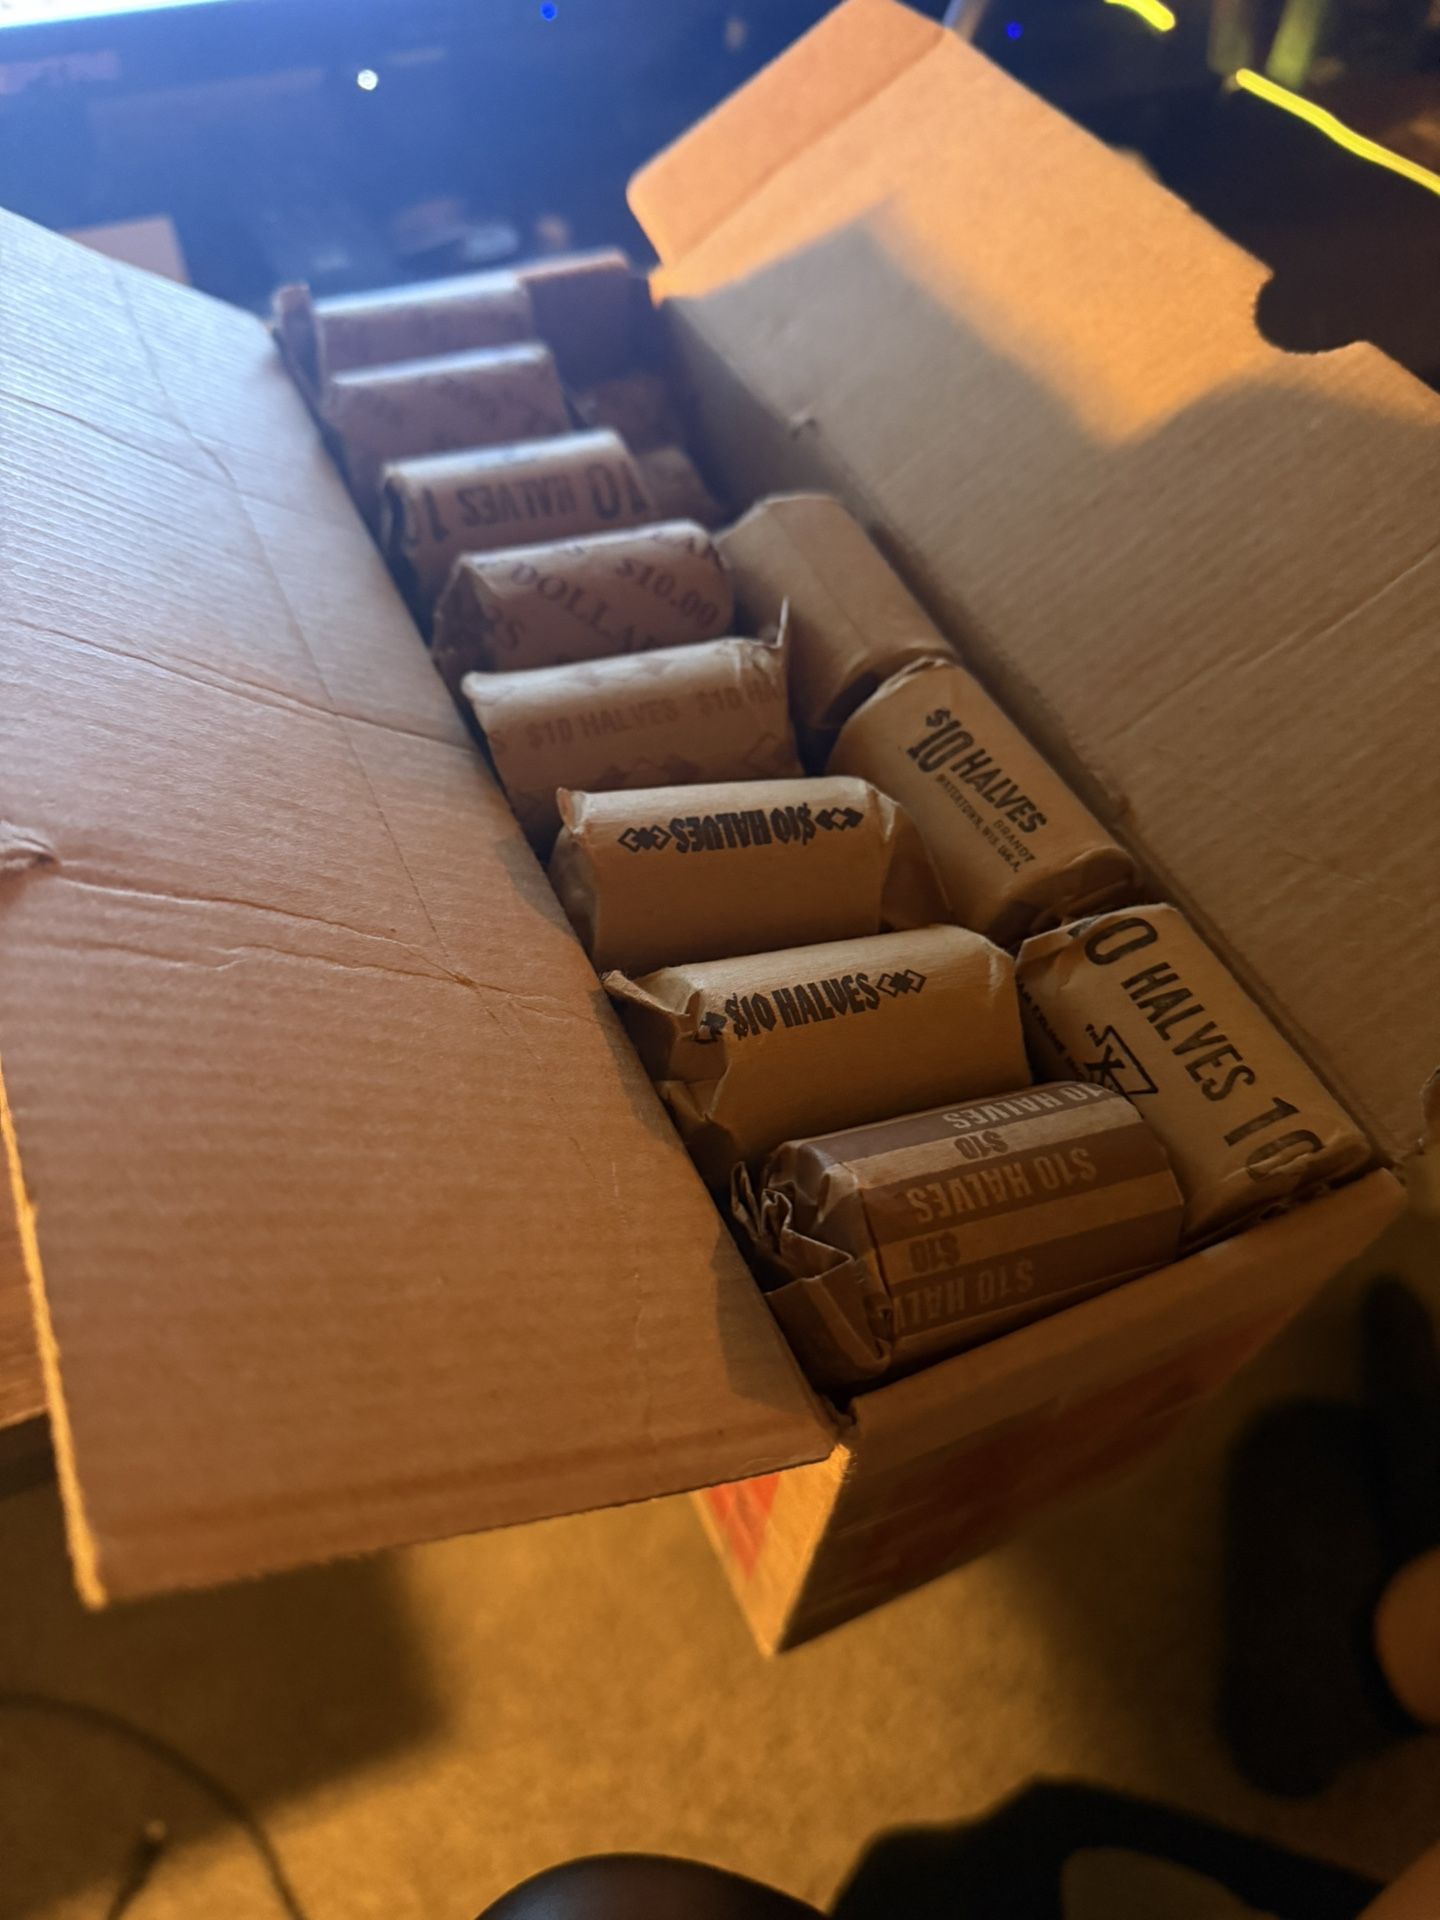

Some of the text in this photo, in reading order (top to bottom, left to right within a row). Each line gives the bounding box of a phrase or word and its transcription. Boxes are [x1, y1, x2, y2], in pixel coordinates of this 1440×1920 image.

[526, 715, 575, 749] $10
[576, 698, 680, 739] HALVES
[906, 708, 1047, 833] $10 HALVES
[668, 802, 817, 854] $10 HALVES
[993, 819, 1036, 862] BRANDT
[724, 972, 881, 1041] $10 HALVES
[1120, 961, 1256, 1101] HALVES
[942, 1091, 1064, 1130] HALVES
[953, 1129, 1009, 1161] $10
[905, 1147, 1097, 1224] $10 HALVES
[909, 1231, 961, 1274] $10
[977, 1257, 1035, 1305] $10
